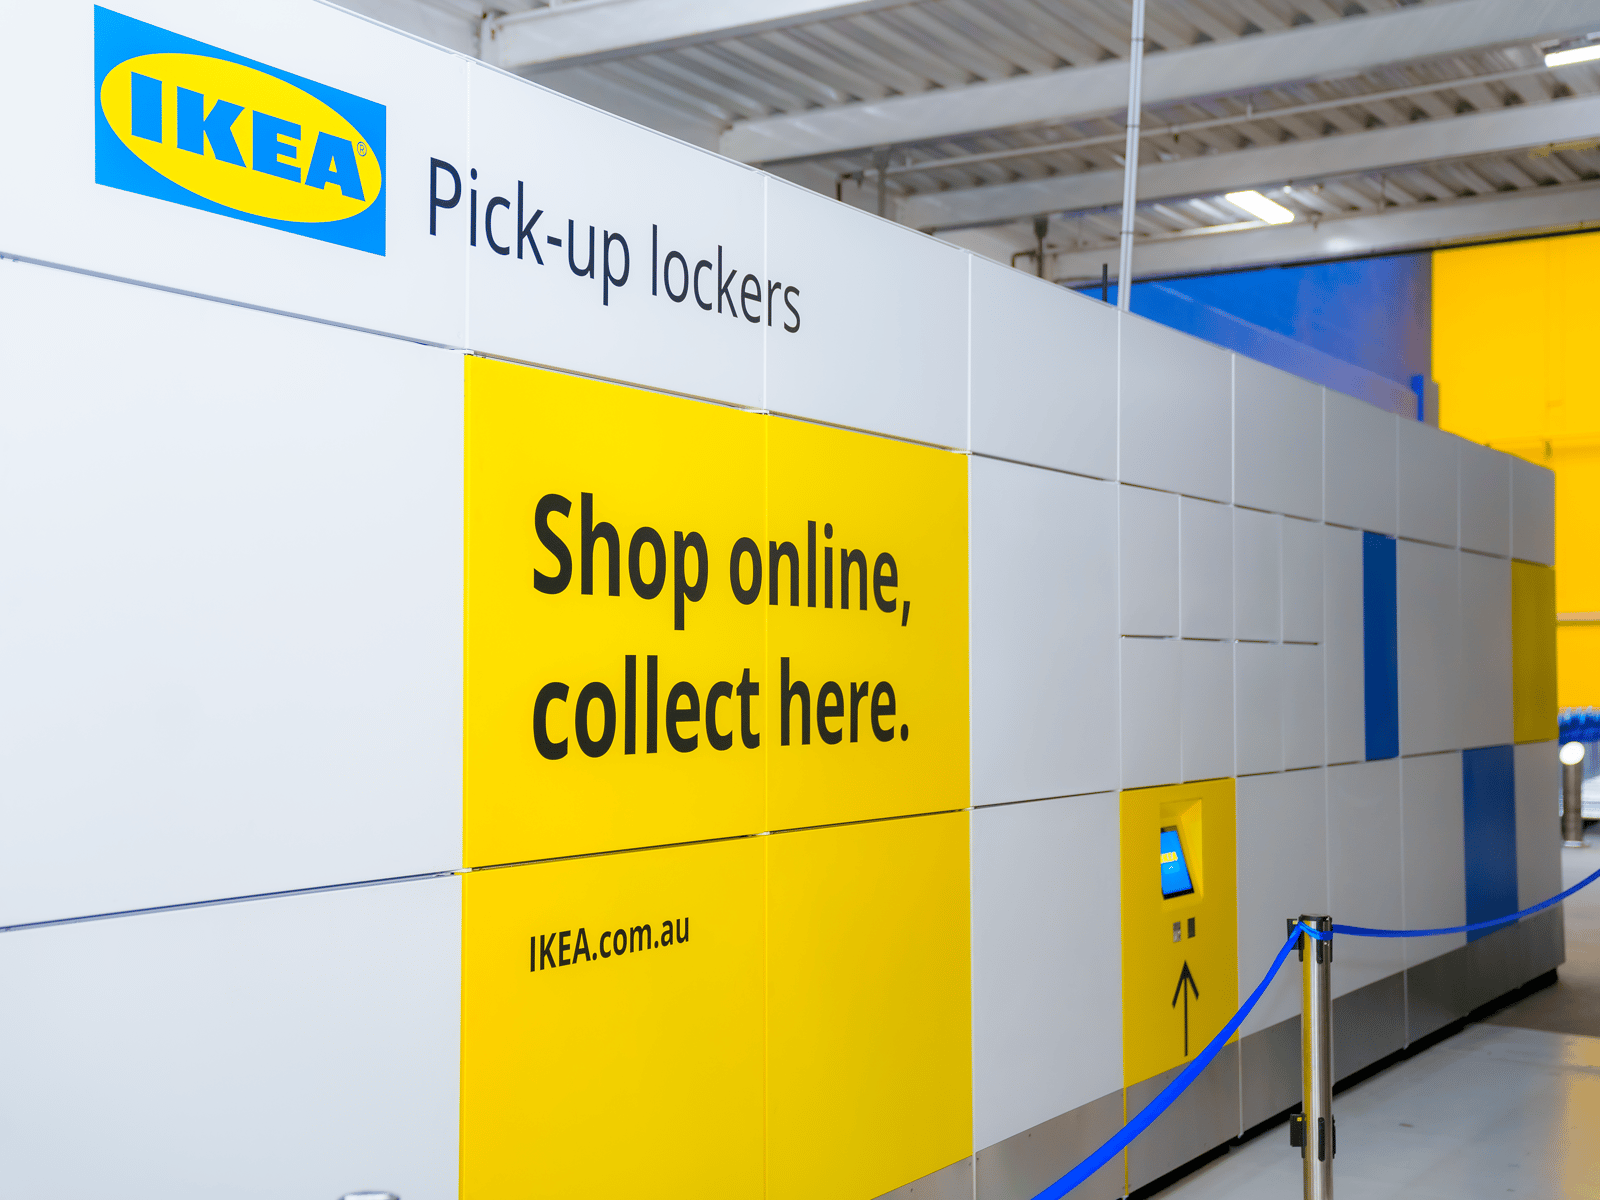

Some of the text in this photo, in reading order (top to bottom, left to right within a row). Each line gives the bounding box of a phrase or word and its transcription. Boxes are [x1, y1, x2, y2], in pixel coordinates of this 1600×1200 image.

[131, 71, 366, 202] IKEA
[429, 156, 801, 334] Pick-up lockers
[533, 492, 911, 631] Shop online,
[532, 654, 909, 761] collect here.
[529, 917, 690, 973] IKEA.com.au
